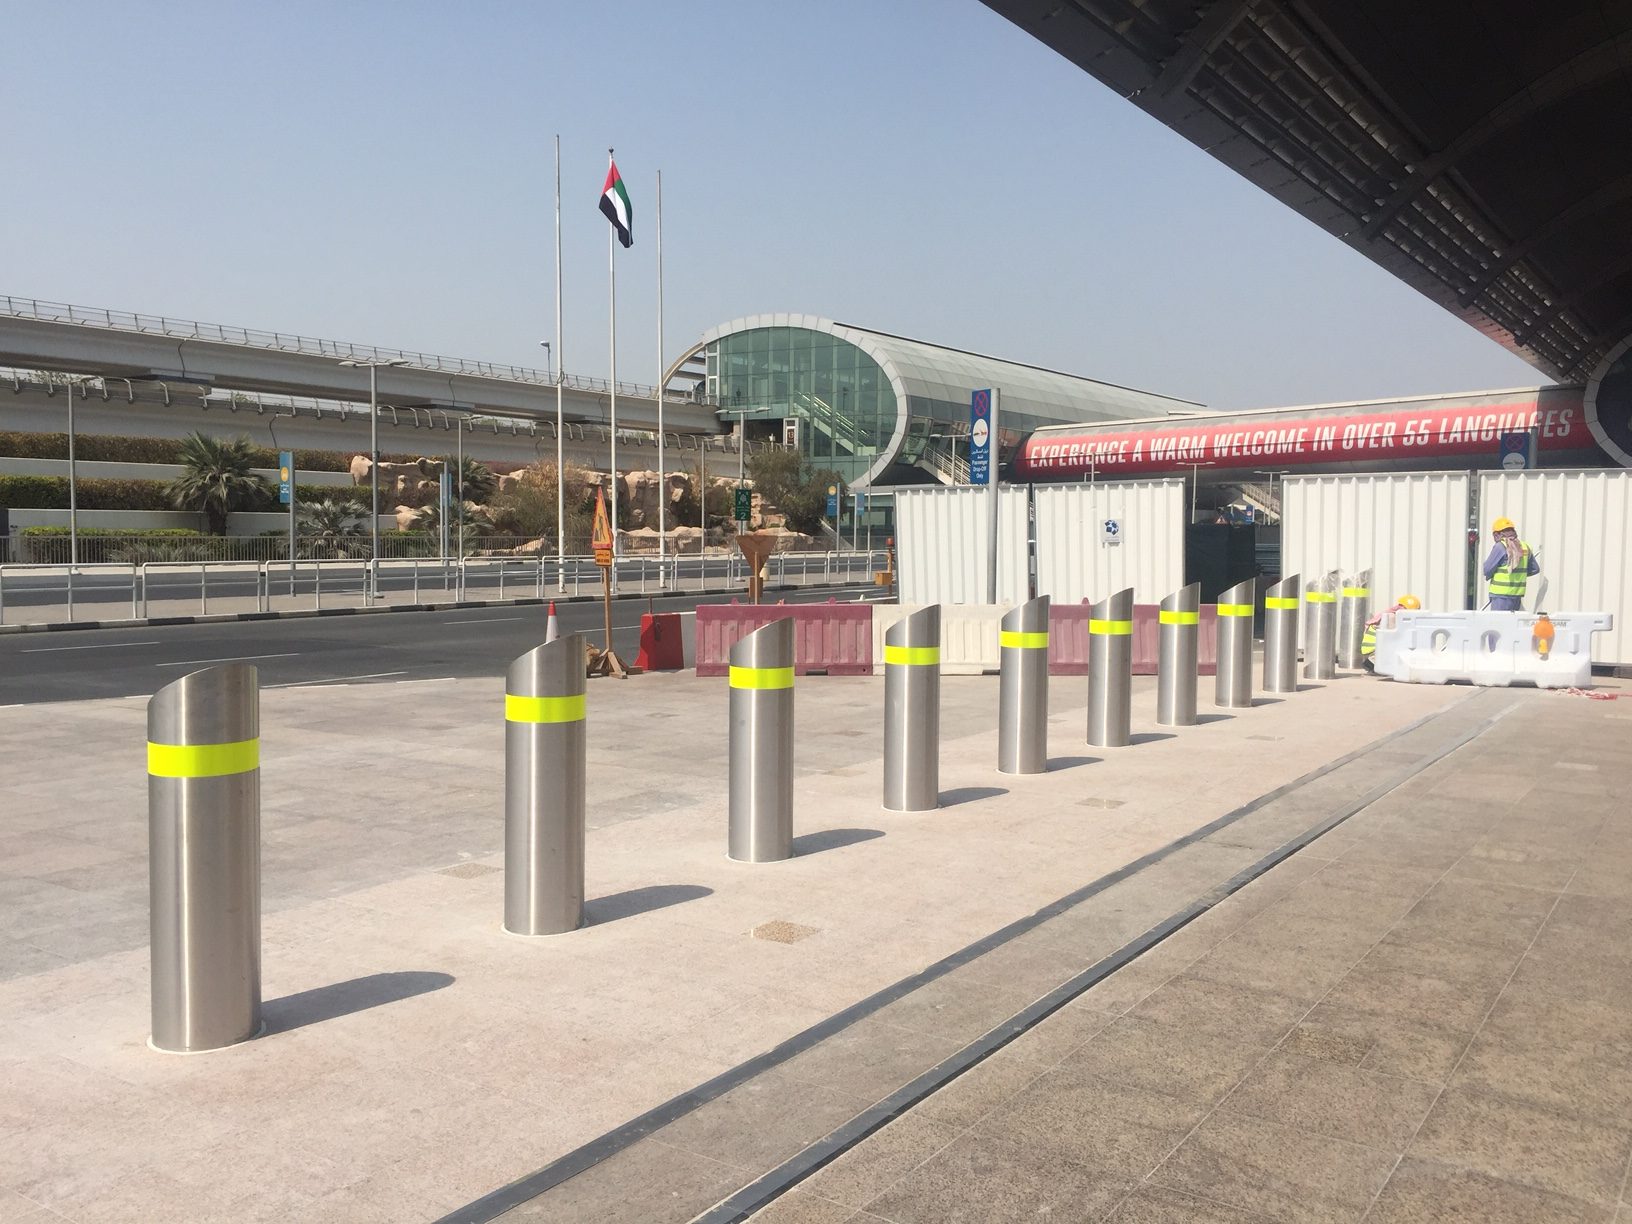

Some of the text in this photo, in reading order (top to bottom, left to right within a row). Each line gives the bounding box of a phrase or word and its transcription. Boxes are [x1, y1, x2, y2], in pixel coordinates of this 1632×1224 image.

[1030, 440, 1130, 468] EXPERIENCE
[1132, 439, 1143, 463] A
[1151, 435, 1207, 461] WARM
[1213, 427, 1309, 458] WELCOME
[1312, 425, 1337, 451] IN
[1342, 421, 1397, 450] OVER
[1402, 418, 1433, 446] 55
[740, 512, 747, 520] 2
